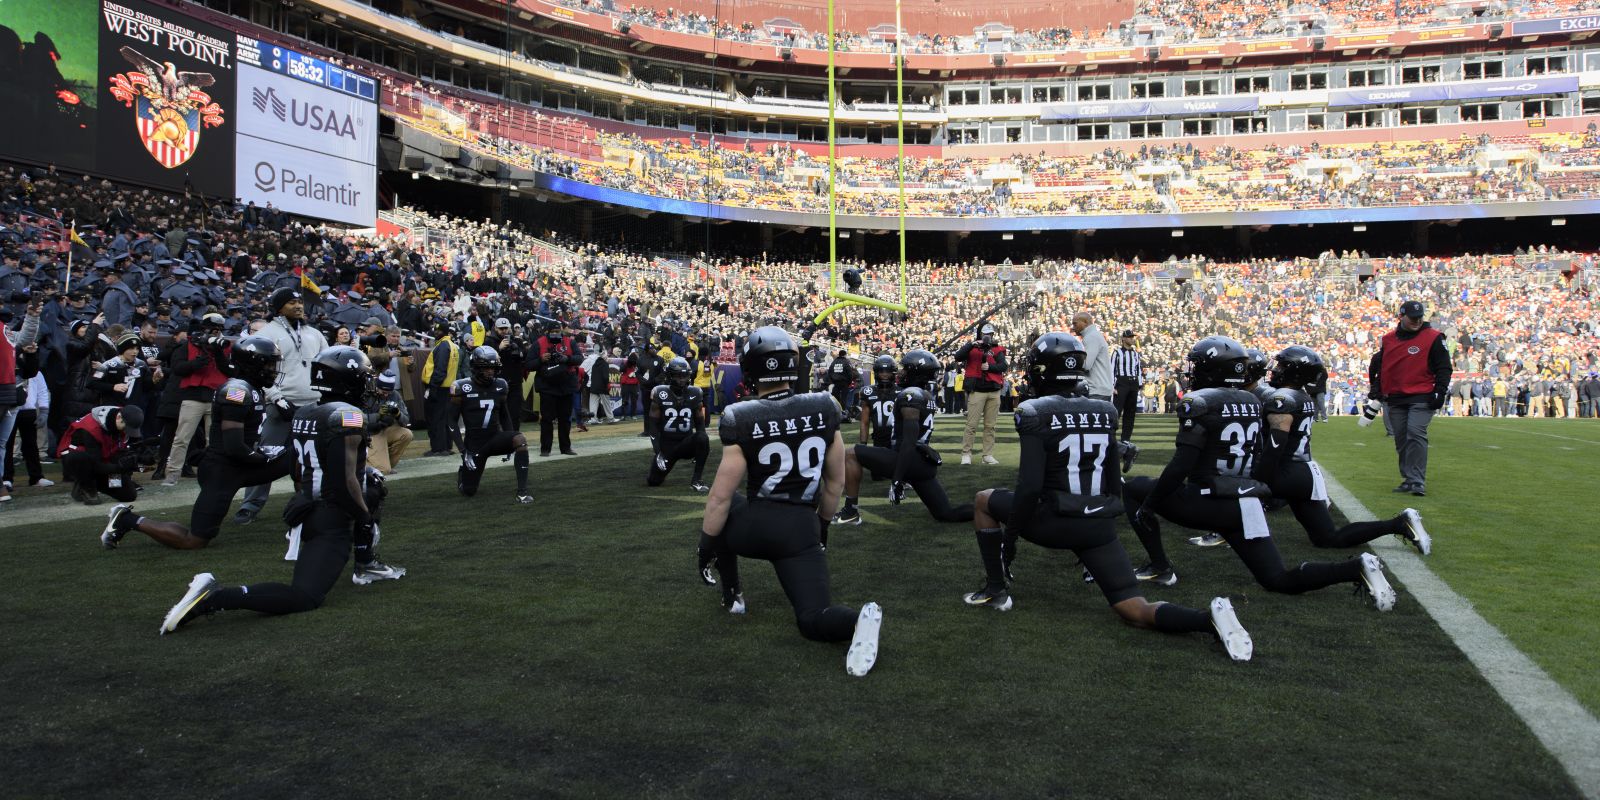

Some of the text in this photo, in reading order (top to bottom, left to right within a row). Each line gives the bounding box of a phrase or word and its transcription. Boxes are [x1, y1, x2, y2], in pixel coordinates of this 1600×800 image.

[104, 0, 134, 17] UNITED
[135, 12, 162, 26] STATES
[163, 21, 195, 38] MILITARY
[197, 33, 229, 49] ACADEMY
[104, 11, 164, 46] WEST
[236, 34, 260, 48] NAVY
[236, 48, 260, 61] ARMY
[290, 58, 324, 83] 58:32
[291, 99, 357, 140] USAA
[281, 168, 361, 206] Palantir
[479, 399, 495, 429] 7
[664, 407, 692, 432] 23
[752, 412, 827, 439] ARMY!
[872, 400, 896, 427] 19
[1050, 413, 1111, 430] ARMY!
[757, 436, 827, 500] 29
[1058, 433, 1110, 497] 17
